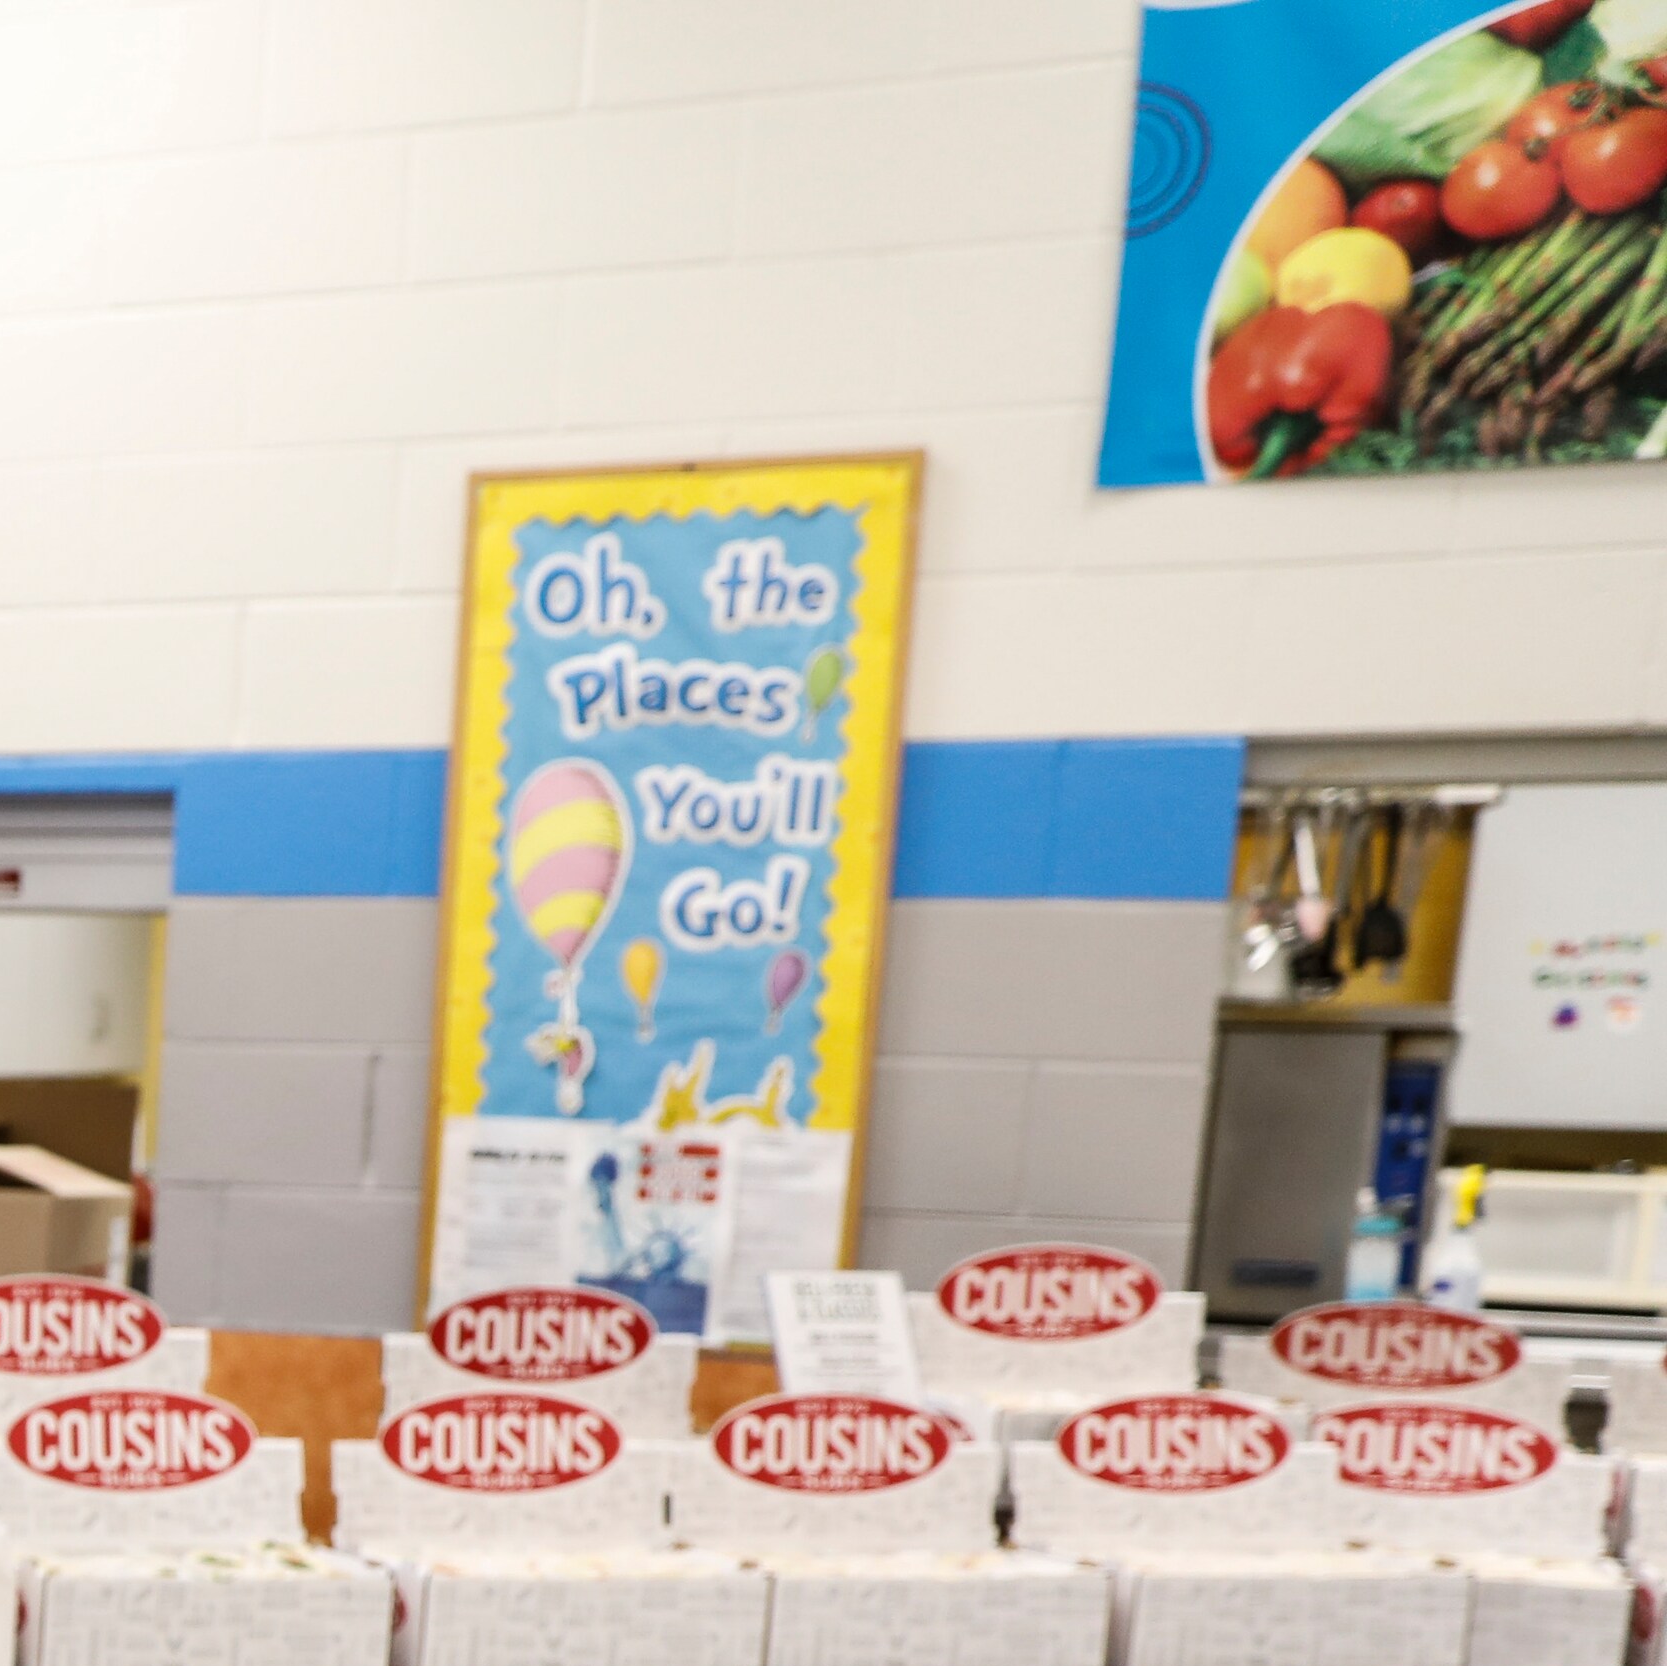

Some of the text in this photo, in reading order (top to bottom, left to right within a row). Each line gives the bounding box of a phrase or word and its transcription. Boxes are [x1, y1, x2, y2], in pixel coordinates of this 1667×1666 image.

[533, 541, 830, 631] Oh, the
[556, 651, 795, 731] Places
[644, 760, 831, 839] You'll
[668, 863, 801, 945] Go!
[953, 1265, 1145, 1326] COUSINS
[444, 1304, 636, 1366] COUSINS
[1288, 1320, 1505, 1378] COUSINS
[25, 1409, 236, 1472] COUSINS
[398, 1411, 607, 1475] COUSINS
[731, 1413, 935, 1476] COUSINS
[1072, 1412, 1276, 1475] COUSINS
